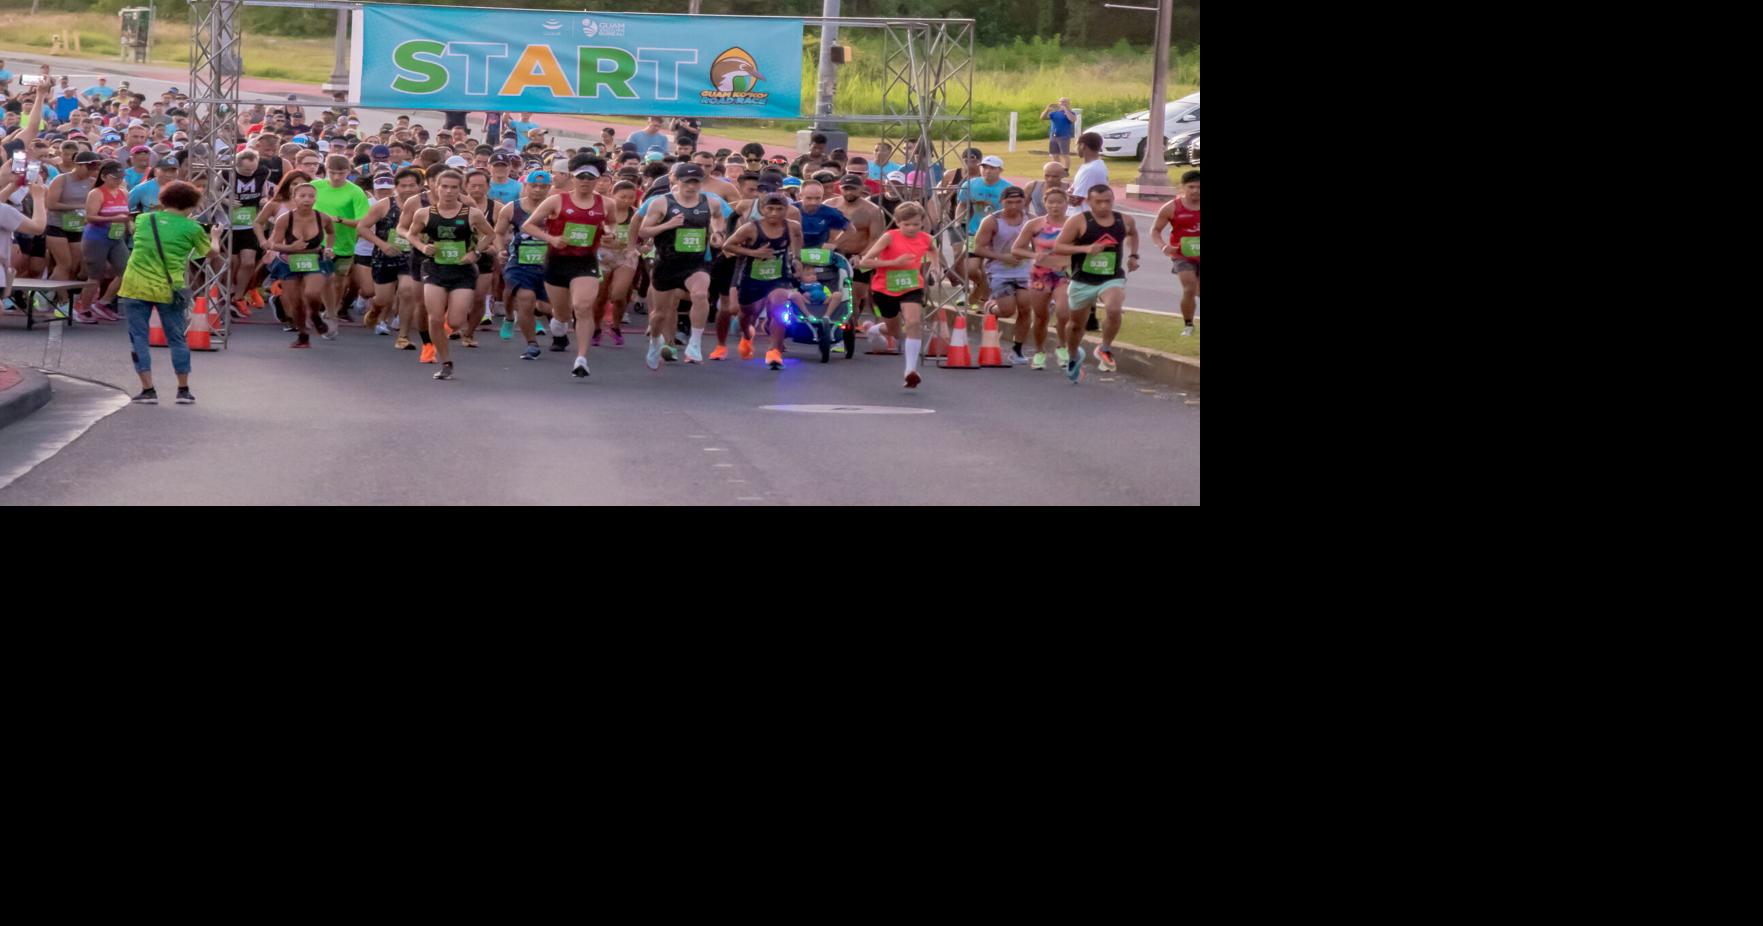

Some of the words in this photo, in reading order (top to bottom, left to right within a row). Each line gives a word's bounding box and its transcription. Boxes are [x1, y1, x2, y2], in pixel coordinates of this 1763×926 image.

[391, 39, 699, 99] START
[700, 90, 732, 98] GUAM
[700, 97, 734, 105] ROAD
